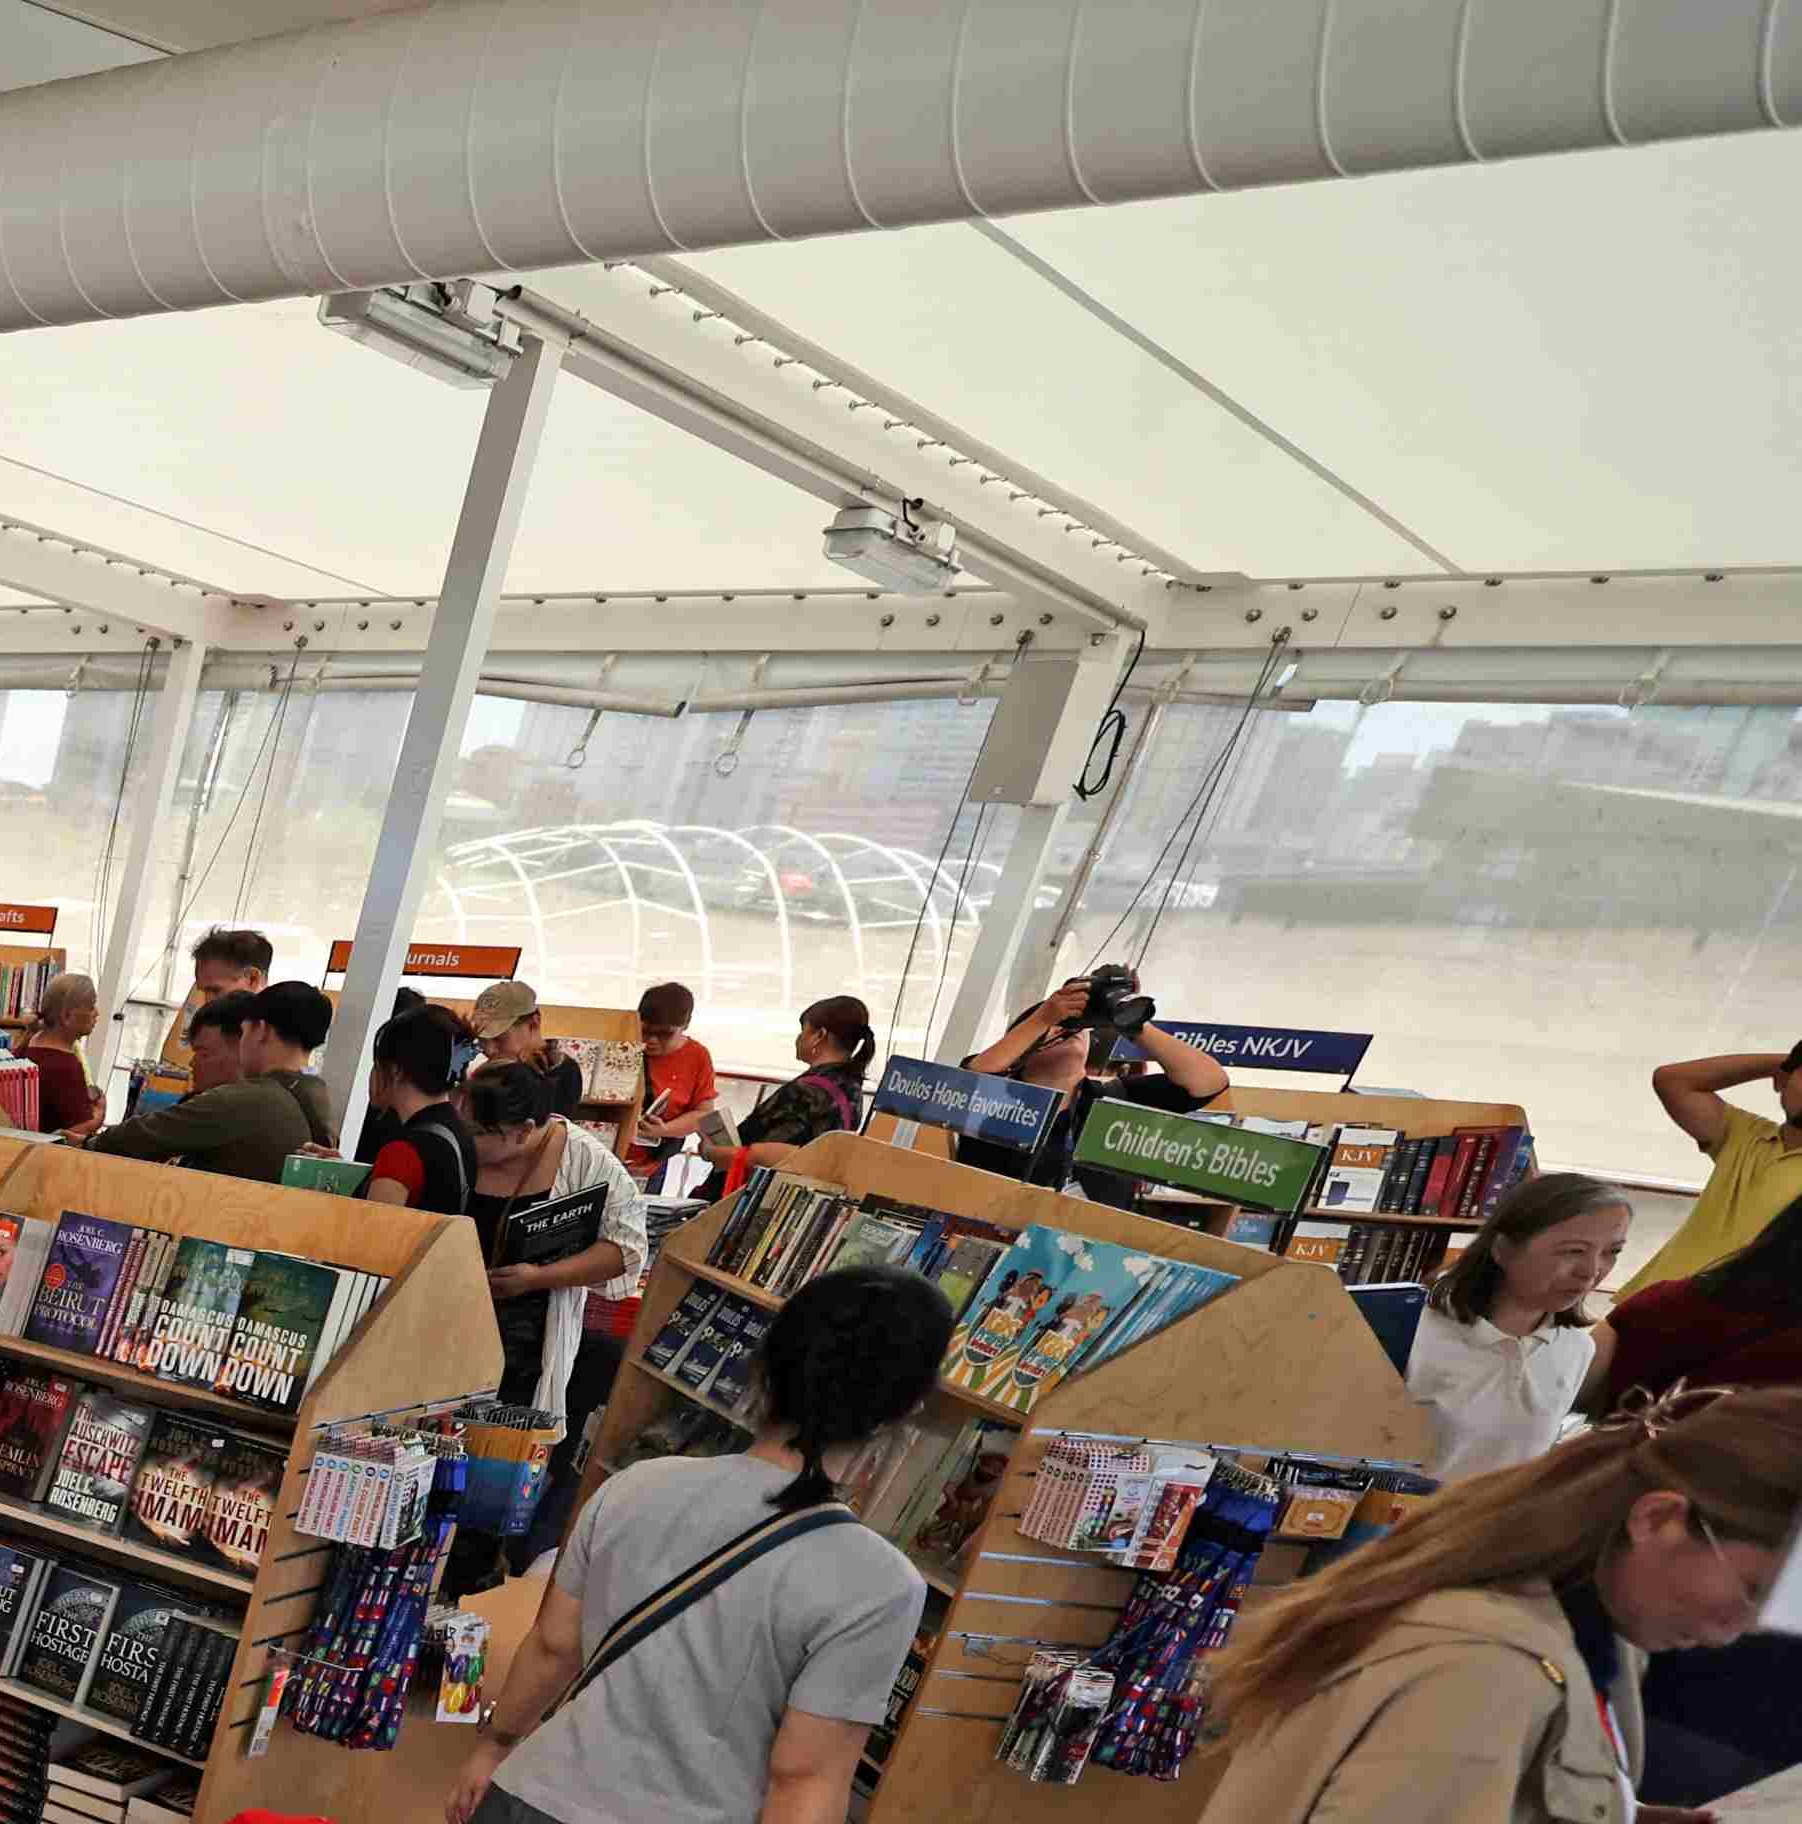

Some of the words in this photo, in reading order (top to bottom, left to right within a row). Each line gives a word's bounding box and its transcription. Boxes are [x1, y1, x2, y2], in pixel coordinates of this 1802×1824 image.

[405, 949, 460, 967] urnals
[1241, 1035, 1312, 1060] NKJV
[887, 1069, 932, 1101] Doulos
[933, 1078, 968, 1112] Hope
[967, 1086, 1040, 1129] favourites
[1103, 1119, 1206, 1169] Children's
[1208, 1142, 1279, 1188] Bibles
[1339, 1149, 1378, 1166] KJV
[526, 1217, 551, 1236] THE
[551, 1203, 593, 1230] EARTH
[56, 1229, 125, 1256] ROSENBERG
[1293, 1242, 1332, 1259] KJV
[34, 1303, 100, 1331] PROTOCOL
[40, 1285, 106, 1316] BEIRUT
[160, 1299, 236, 1329] DAMASCUS
[153, 1313, 230, 1353] COUNT
[237, 1317, 308, 1349] DAMASCUS
[147, 1338, 224, 1384] DOWN
[229, 1331, 304, 1375] COUNT
[224, 1357, 296, 1406] DOWN
[69, 1417, 140, 1456] AUSCHWITZ
[61, 1440, 132, 1485] ESCAPE
[170, 1467, 188, 1482] THE
[55, 1468, 84, 1493] JOEL
[141, 1471, 210, 1505] TWELFTH
[241, 1488, 261, 1505] THE
[48, 1485, 119, 1523] ROSENBERG
[138, 1492, 204, 1530] IMAM
[212, 1494, 273, 1526] TWELFT
[37, 1611, 98, 1647] FIRST
[29, 1630, 90, 1666] HOSTAGE
[107, 1632, 161, 1668] FIRS
[99, 1653, 149, 1684] HOSTA
